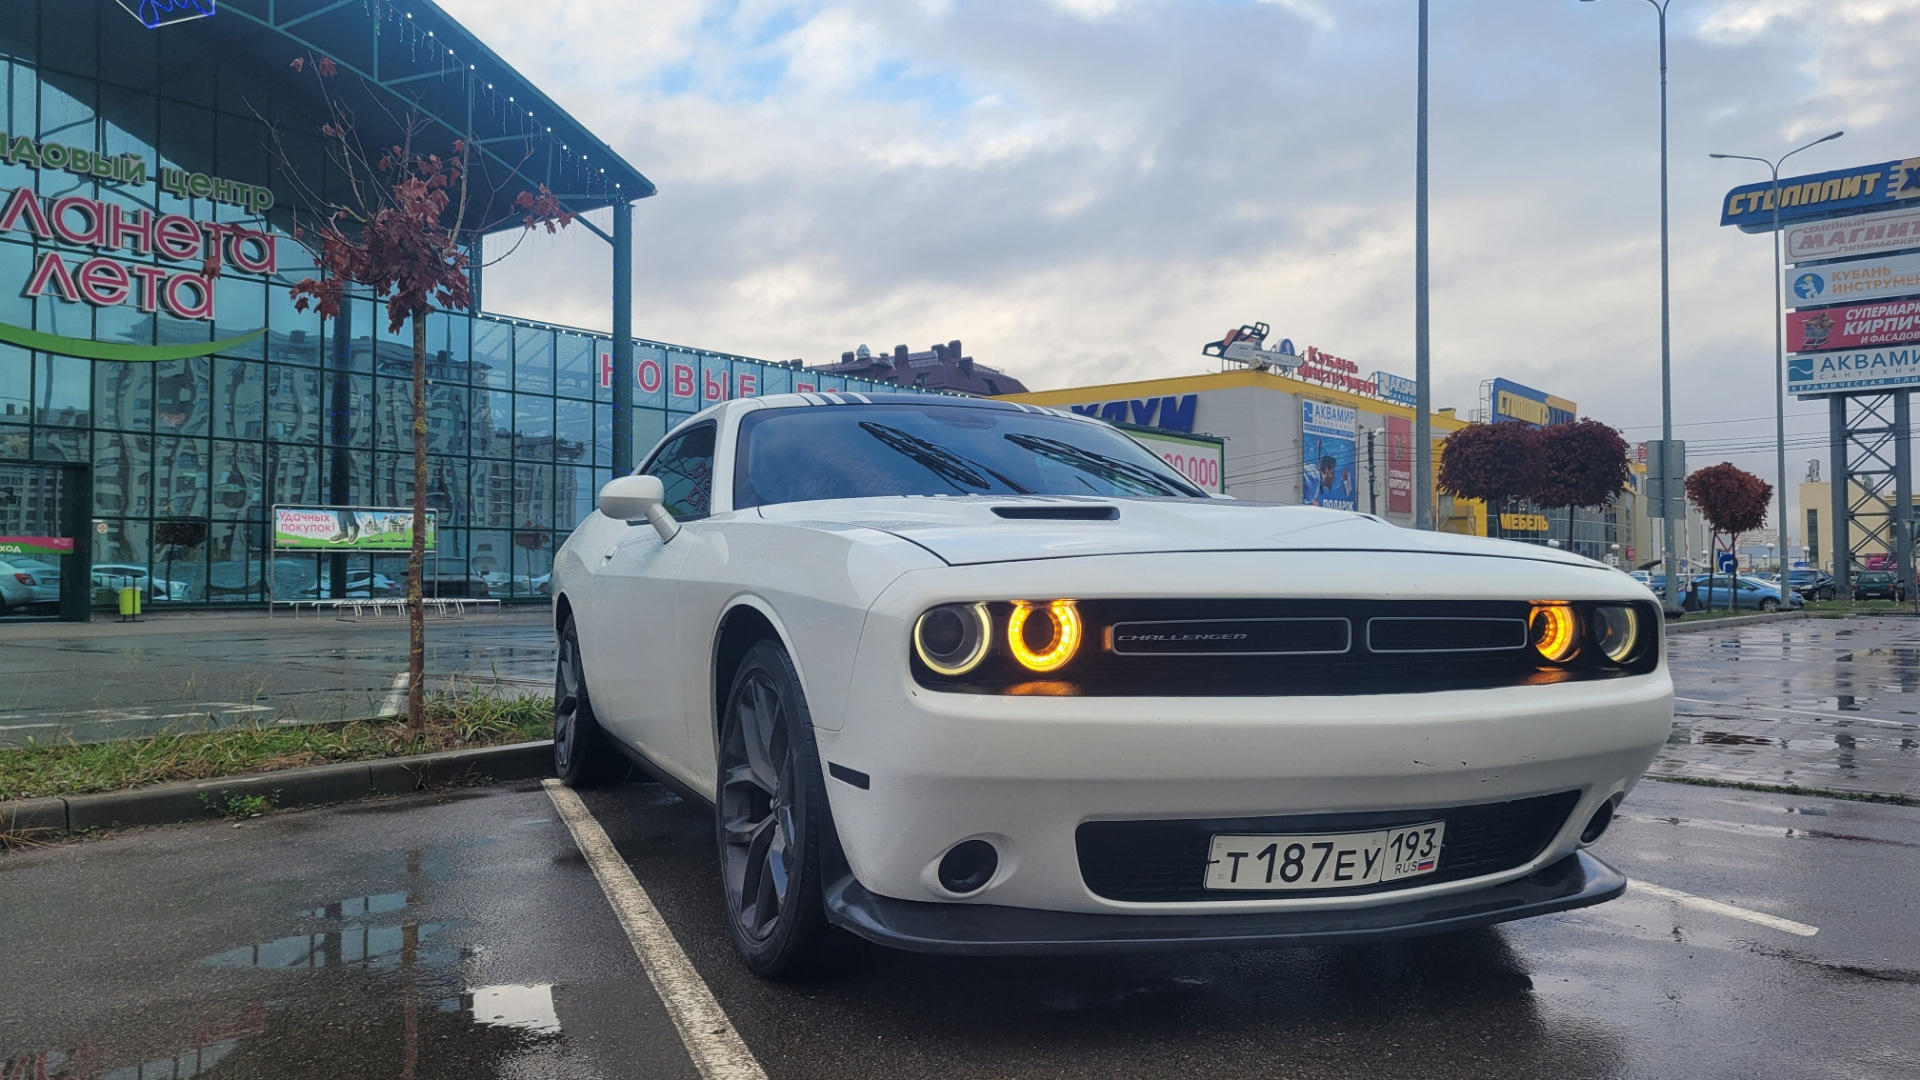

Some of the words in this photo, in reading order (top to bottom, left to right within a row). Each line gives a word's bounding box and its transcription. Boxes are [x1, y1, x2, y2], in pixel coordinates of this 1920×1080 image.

[0, 131, 147, 184] довый
[161, 167, 274, 213] центр
[1728, 172, 1881, 216] СТОЛПЛИТ
[1803, 218, 1865, 233] СЕМЕЙНЫЙ
[1832, 265, 1892, 281] КУБАНЬ
[1860, 335, 1868, 344] И
[1870, 330, 1920, 343] ФАСАДОВ
[1819, 366, 1916, 380] САНТЕХНИ
[1791, 379, 1885, 392] КЕРАМИЧЕСКАЯ
[1314, 403, 1355, 424] АКВАМИР
[279, 511, 330, 522] Удачных
[1500, 513, 1549, 531] МЕБЕЛЬ
[281, 522, 335, 533] покупок!
[1118, 633, 1248, 641] CHALLENGER
[1390, 827, 1437, 863] 193
[1395, 860, 1418, 874] RUS
